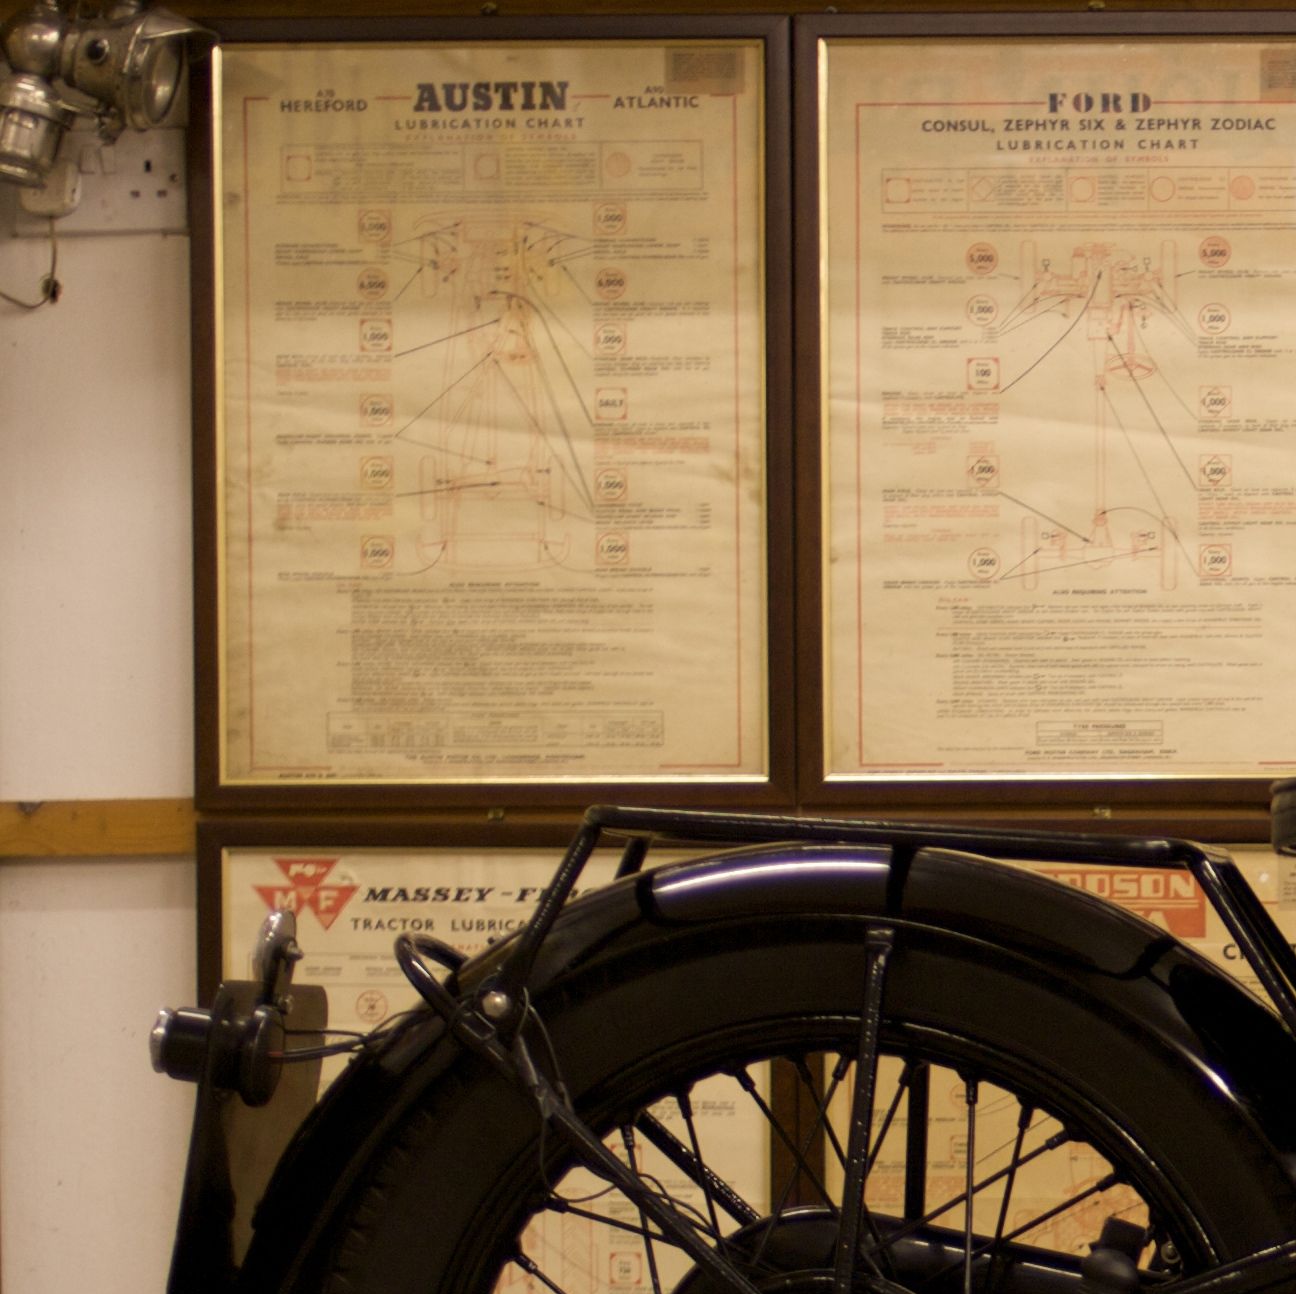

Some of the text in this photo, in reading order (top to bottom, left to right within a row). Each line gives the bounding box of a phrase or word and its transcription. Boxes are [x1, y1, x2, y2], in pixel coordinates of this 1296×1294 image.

[413, 81, 569, 113] AUSTIN
[613, 96, 700, 109] ATLANTIC
[1047, 92, 1152, 113] FORD
[280, 100, 368, 113] HEREFORD
[395, 117, 585, 131] LUBRICATION CHART
[922, 117, 1276, 135] CONSUL, ZEPHYR SIX & ZEPHYR ZODIAC
[997, 138, 1200, 151] LUBRICATION CHART
[319, 890, 339, 908] F
[364, 887, 496, 902] MASSEY
[350, 918, 529, 931] TRACTOR LUBRICA
